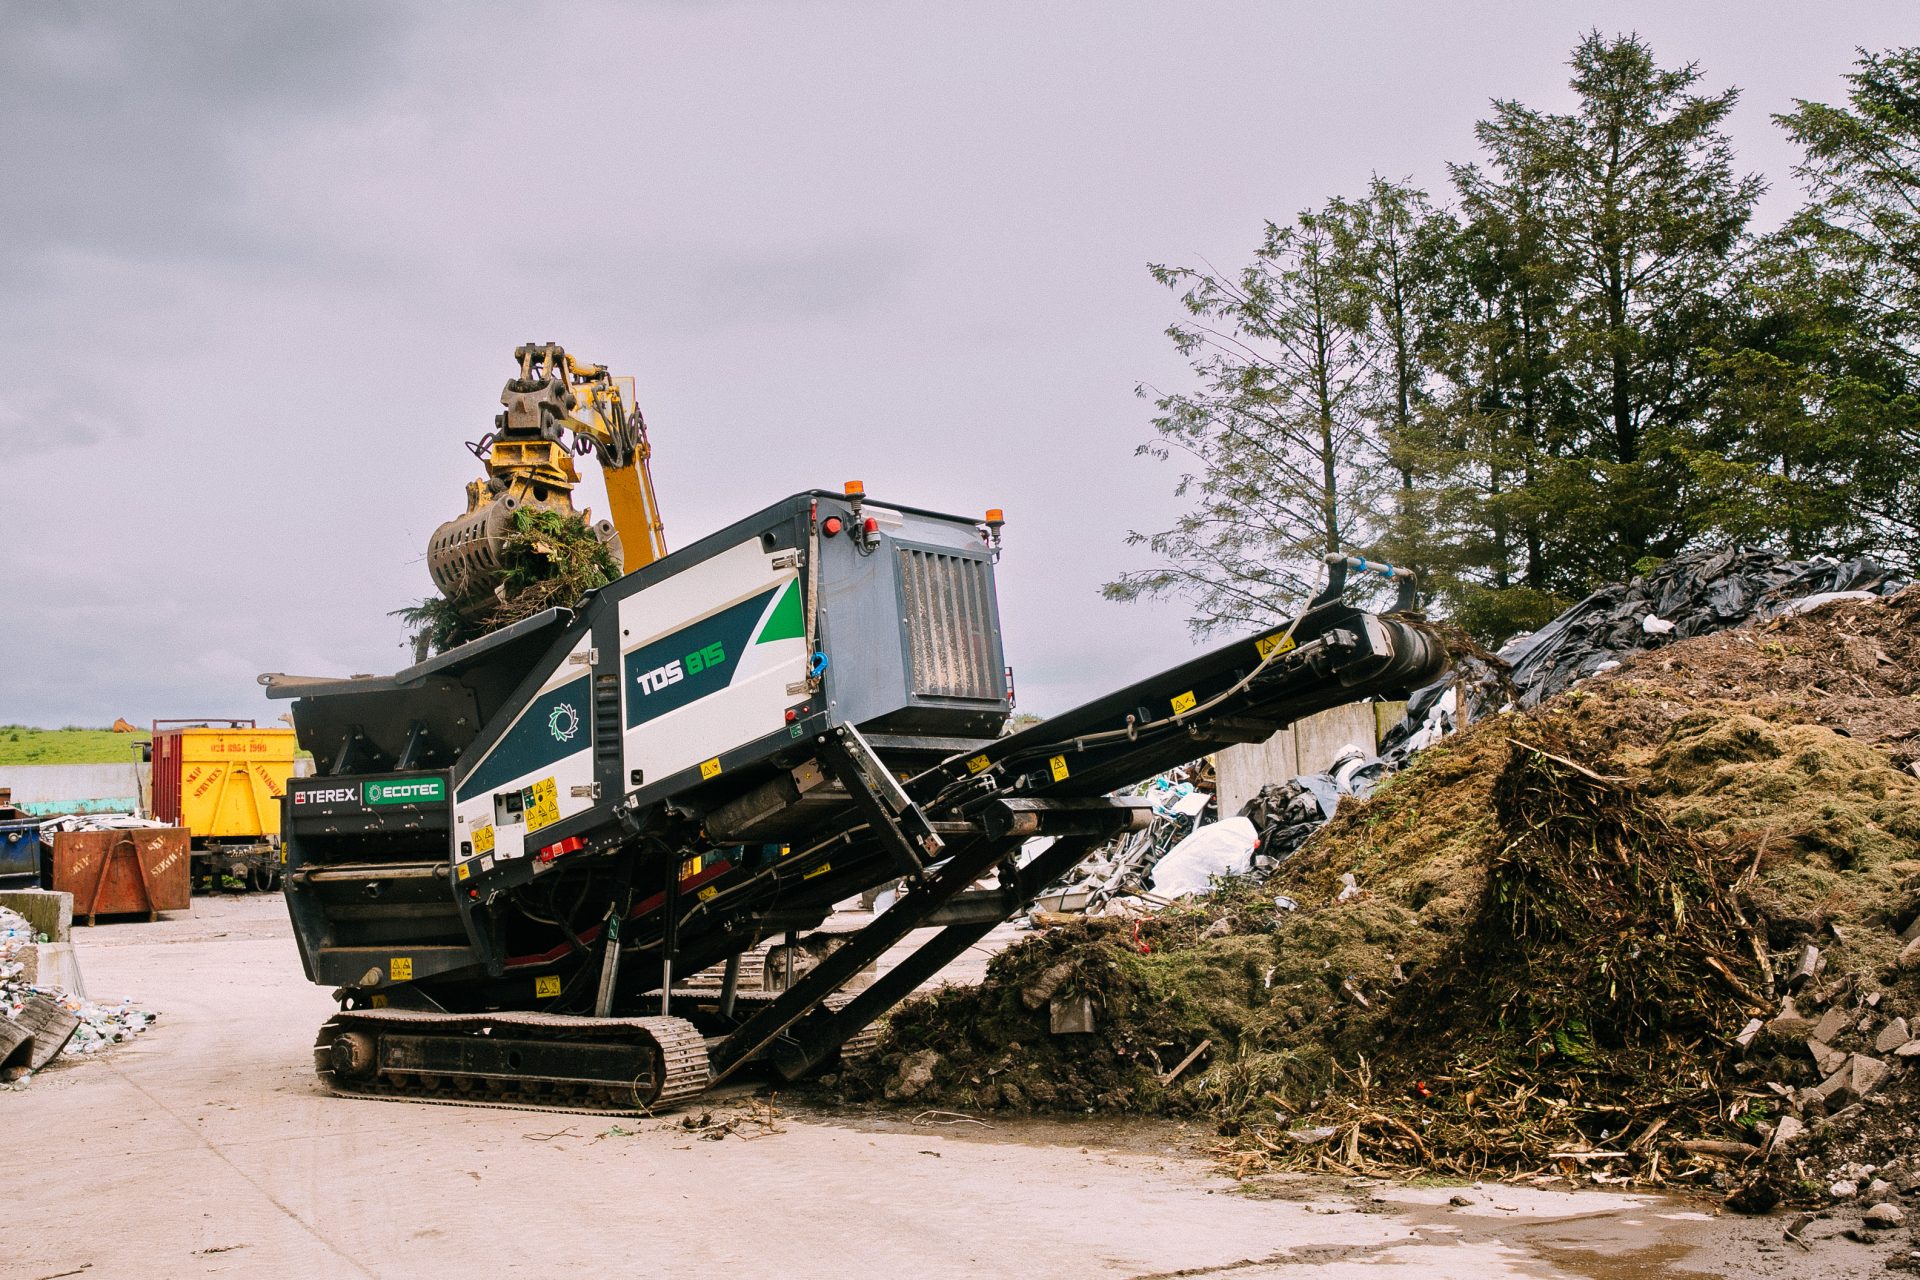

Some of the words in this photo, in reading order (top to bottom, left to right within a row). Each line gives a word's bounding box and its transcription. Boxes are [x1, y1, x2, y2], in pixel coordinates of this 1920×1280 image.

[636, 659, 684, 696] TDS
[685, 640, 726, 676] 815
[186, 766, 202, 784] SKIP
[194, 767, 223, 798] SERVICES
[306, 788, 355, 804] TEREX
[382, 783, 439, 798] ECOTEC
